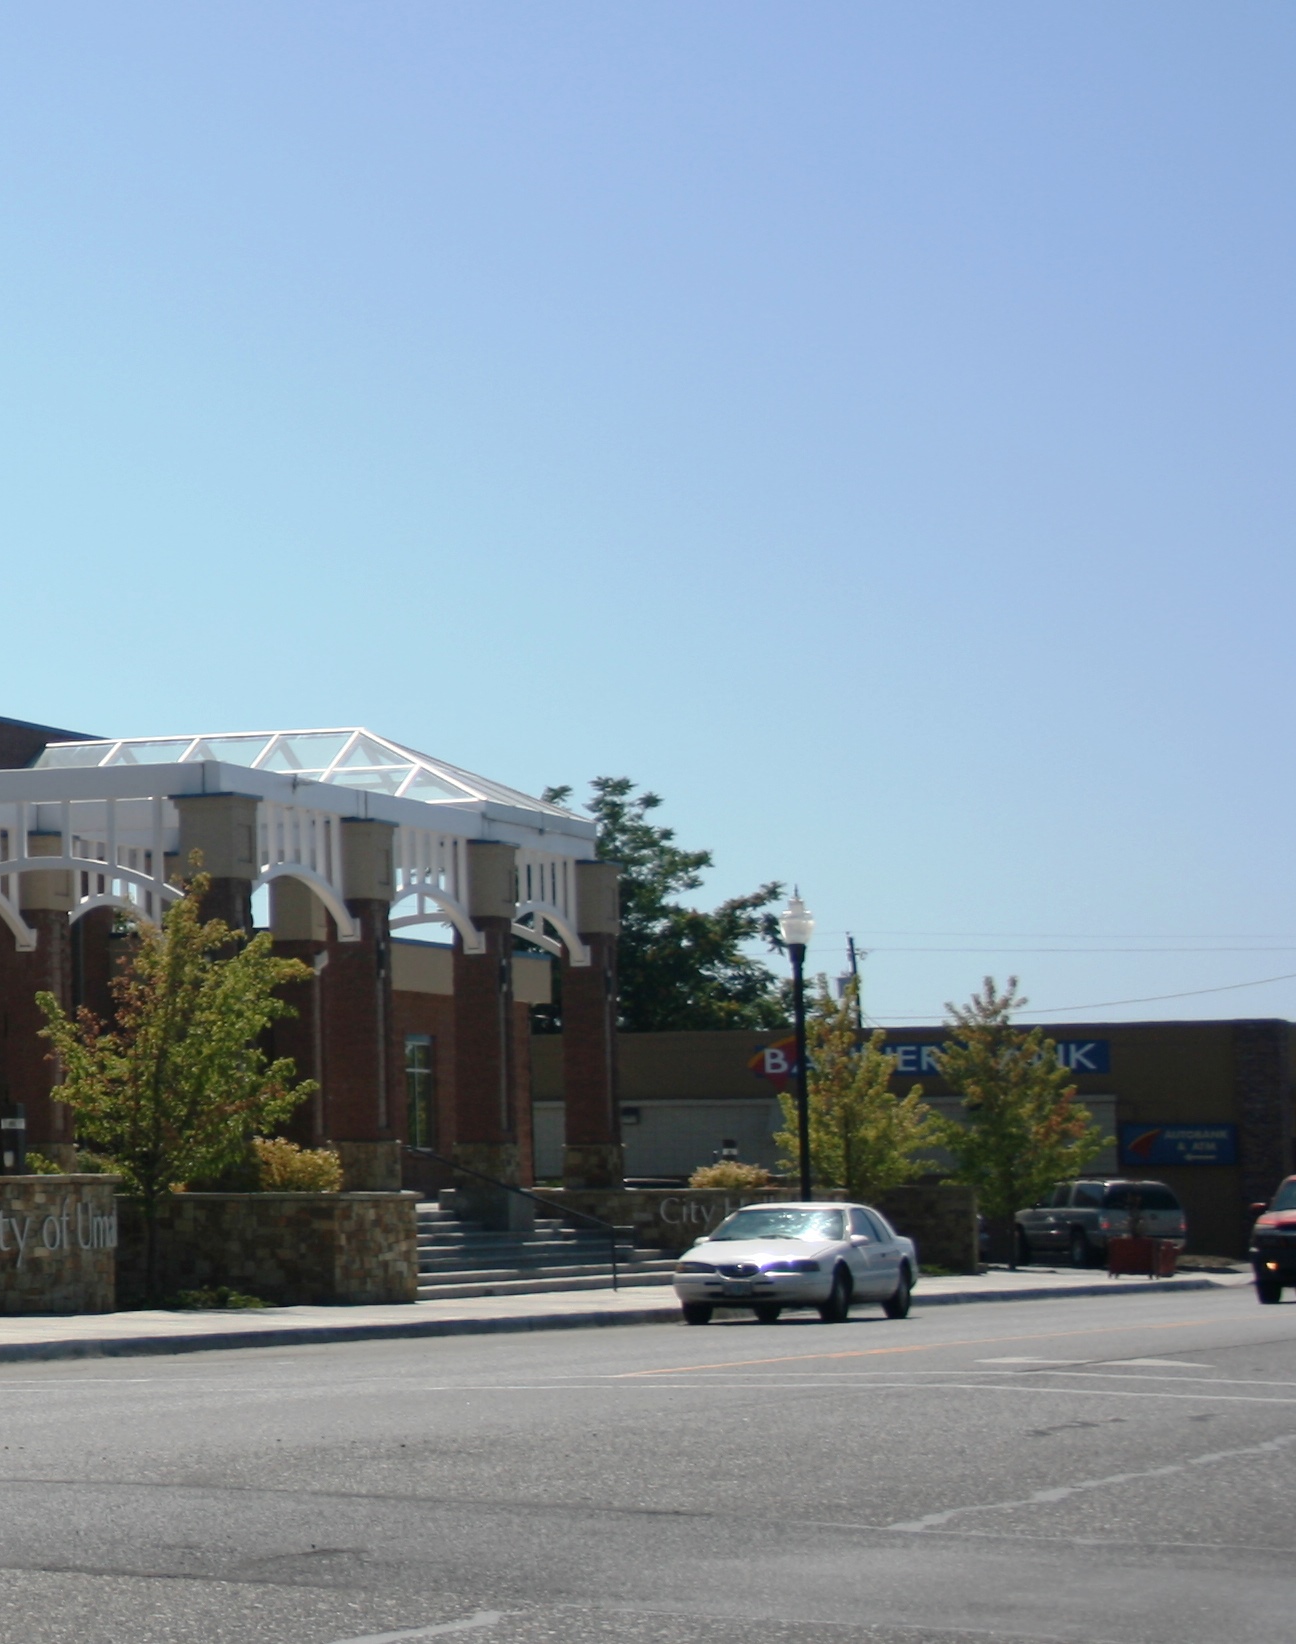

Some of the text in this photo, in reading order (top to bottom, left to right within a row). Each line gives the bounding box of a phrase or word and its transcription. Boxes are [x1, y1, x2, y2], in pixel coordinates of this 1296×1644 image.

[764, 1045, 941, 1073] BER
[43, 1197, 70, 1250] of
[660, 1197, 715, 1231] City
